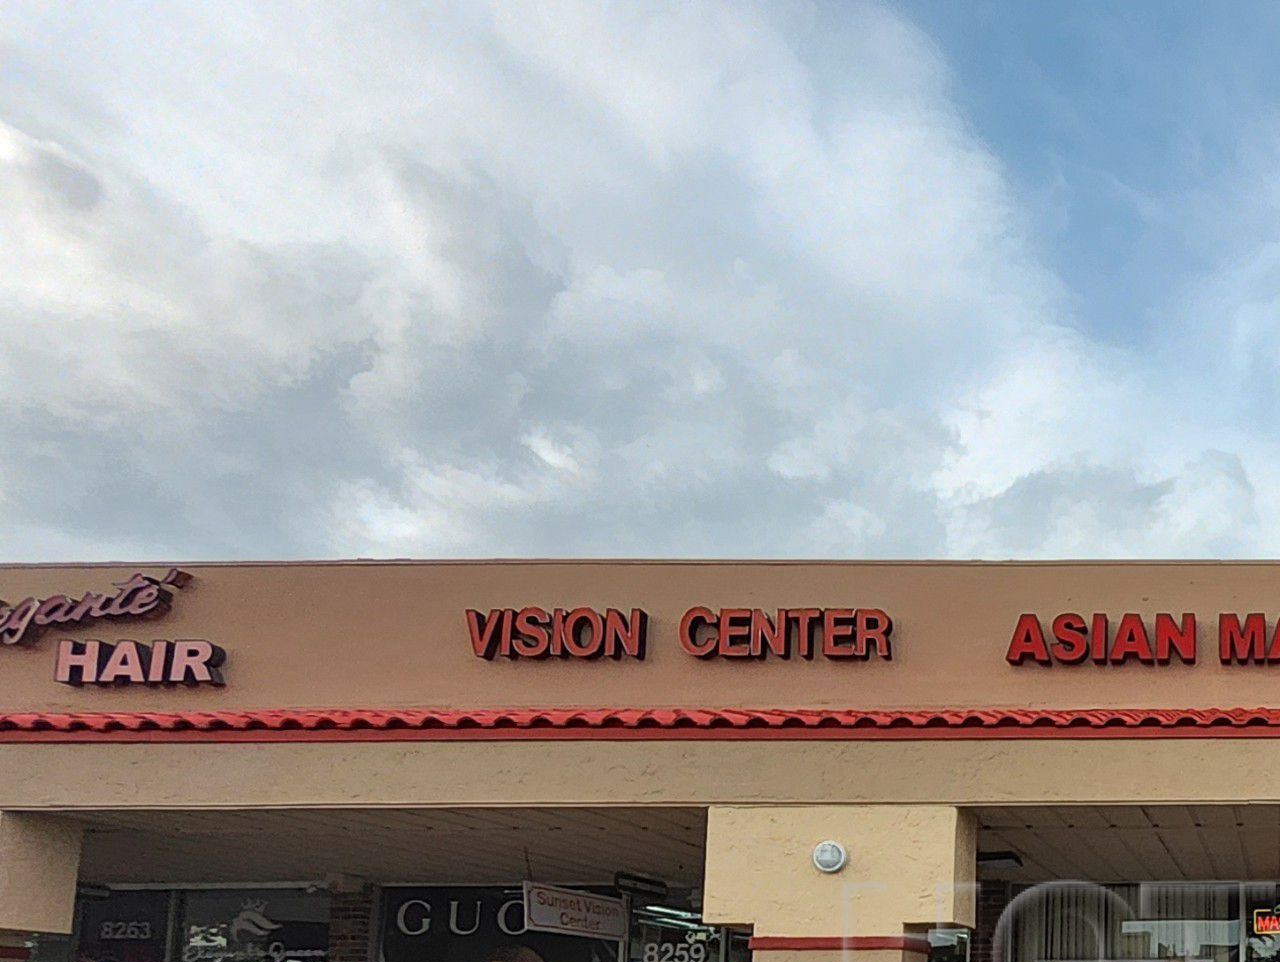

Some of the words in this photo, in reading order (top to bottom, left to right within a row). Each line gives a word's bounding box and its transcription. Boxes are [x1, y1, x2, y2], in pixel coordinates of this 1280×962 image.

[465, 608, 648, 659] VISION
[678, 606, 893, 660] CENTER
[1006, 613, 1196, 665] ASIAN
[55, 640, 222, 686] HAIR
[536, 891, 582, 912] Sunset
[583, 899, 619, 917] Vision
[560, 912, 600, 930] Center
[100, 921, 152, 940] 8263
